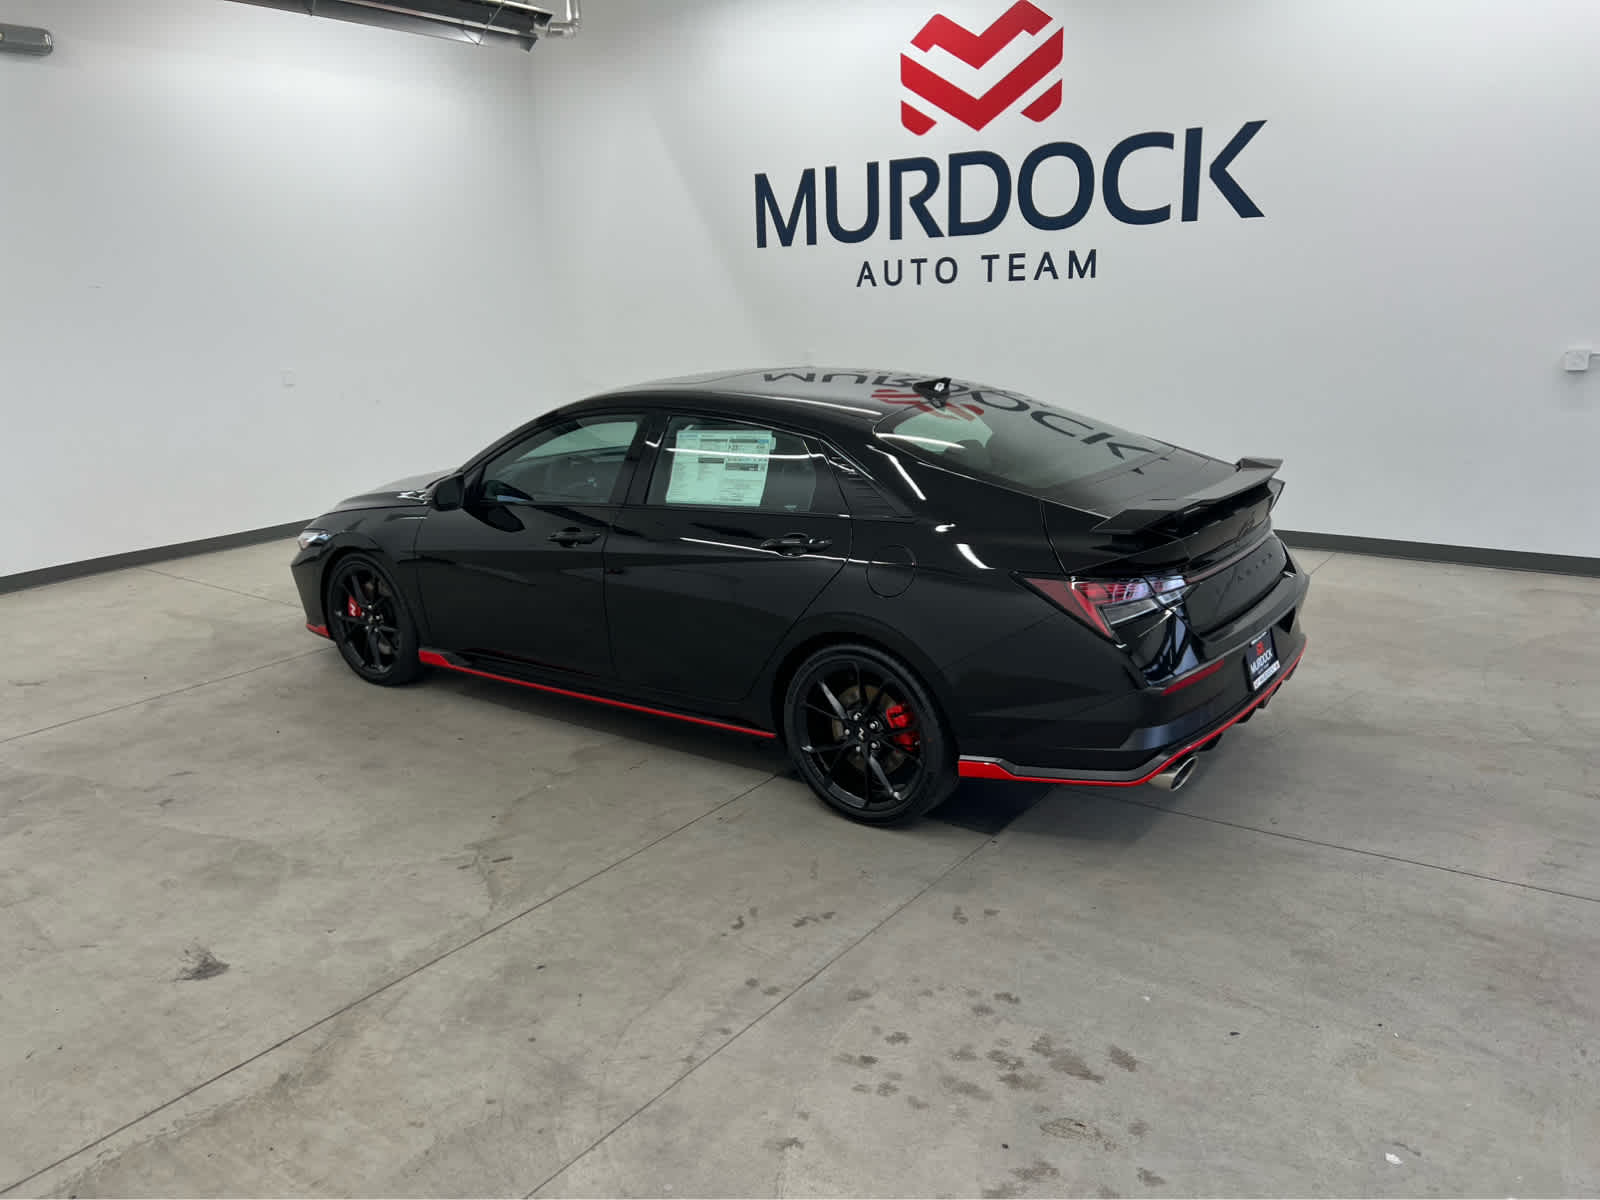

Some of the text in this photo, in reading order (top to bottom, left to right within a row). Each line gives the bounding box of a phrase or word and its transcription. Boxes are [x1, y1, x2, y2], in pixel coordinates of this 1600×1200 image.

[755, 120, 1267, 248] MURDOCK
[856, 248, 1097, 288] AUTO TEAM
